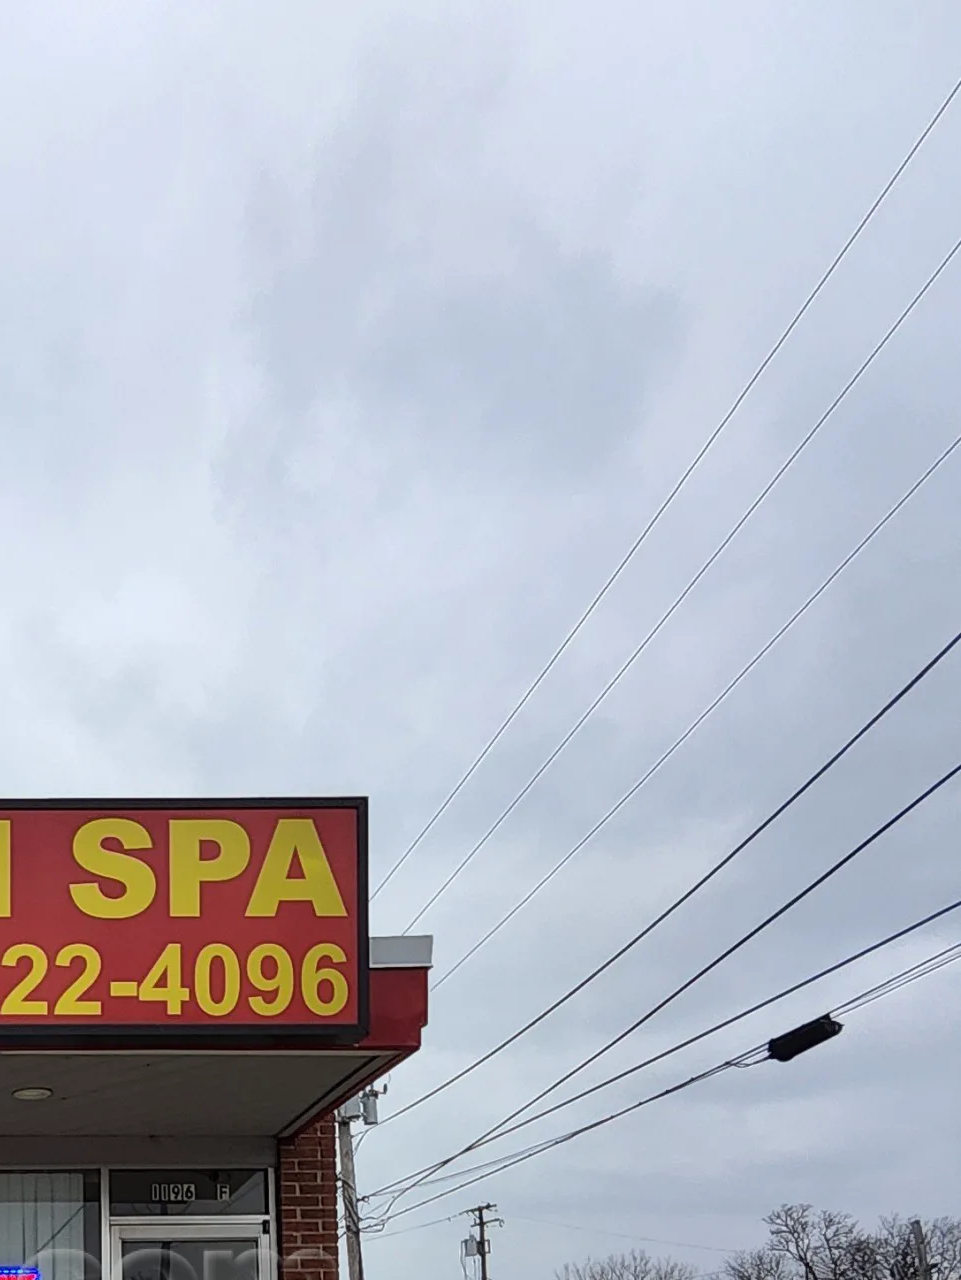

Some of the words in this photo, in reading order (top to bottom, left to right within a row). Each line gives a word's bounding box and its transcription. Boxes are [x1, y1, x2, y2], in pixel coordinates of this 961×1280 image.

[68, 817, 349, 920] SPA
[151, 1184, 196, 1200] 1196
[217, 1184, 230, 1200] F
